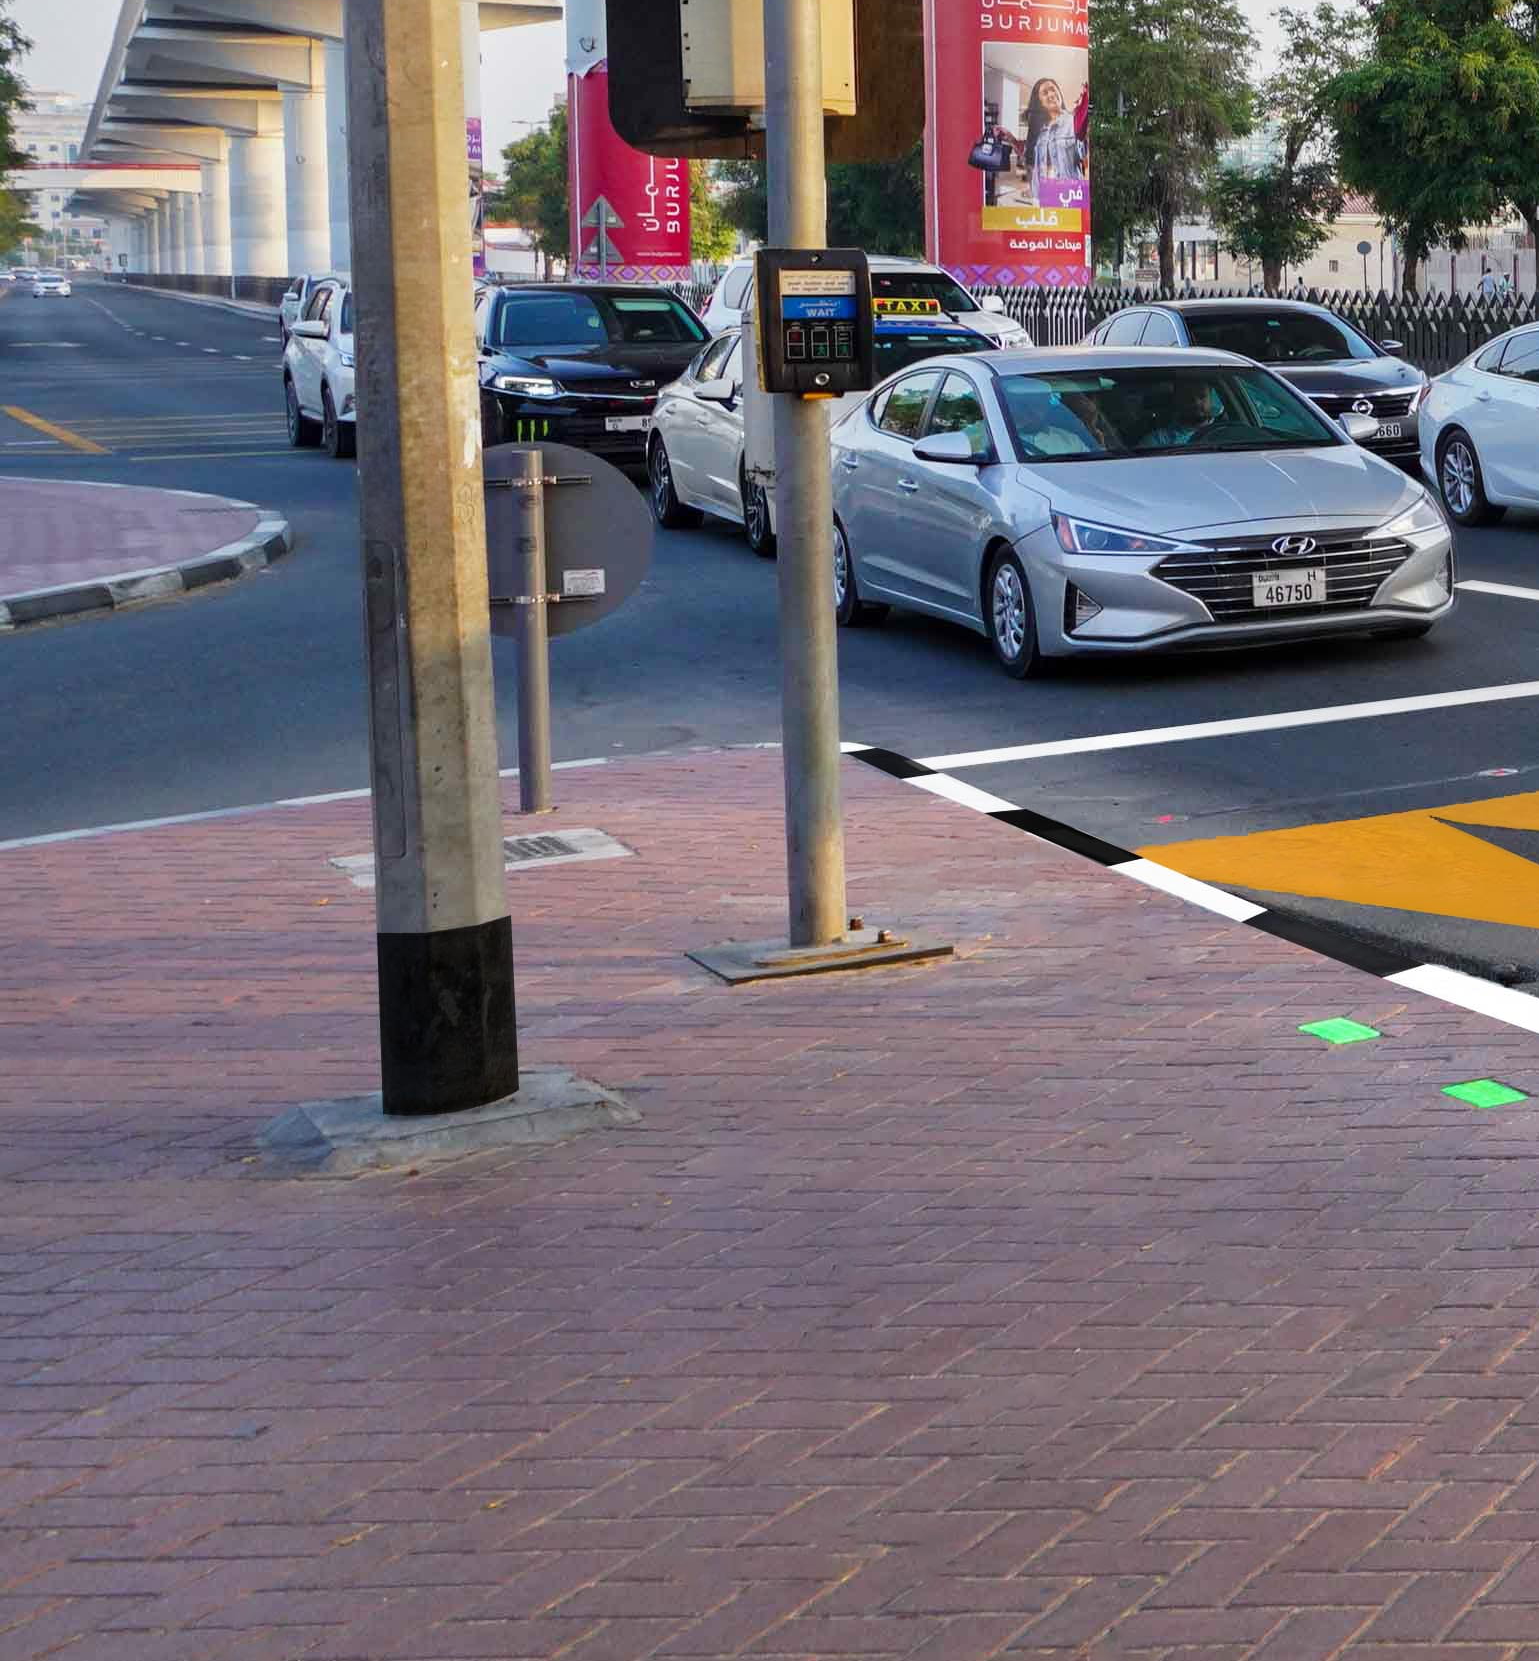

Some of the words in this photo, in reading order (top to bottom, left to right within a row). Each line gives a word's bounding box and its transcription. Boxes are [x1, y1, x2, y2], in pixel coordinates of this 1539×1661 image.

[1059, 185, 1083, 208] في
[1015, 208, 1059, 229] قلب
[806, 308, 835, 317] WAIT
[884, 300, 929, 312] TAXI
[1307, 571, 1316, 581] H
[1265, 583, 1312, 602] 46750
